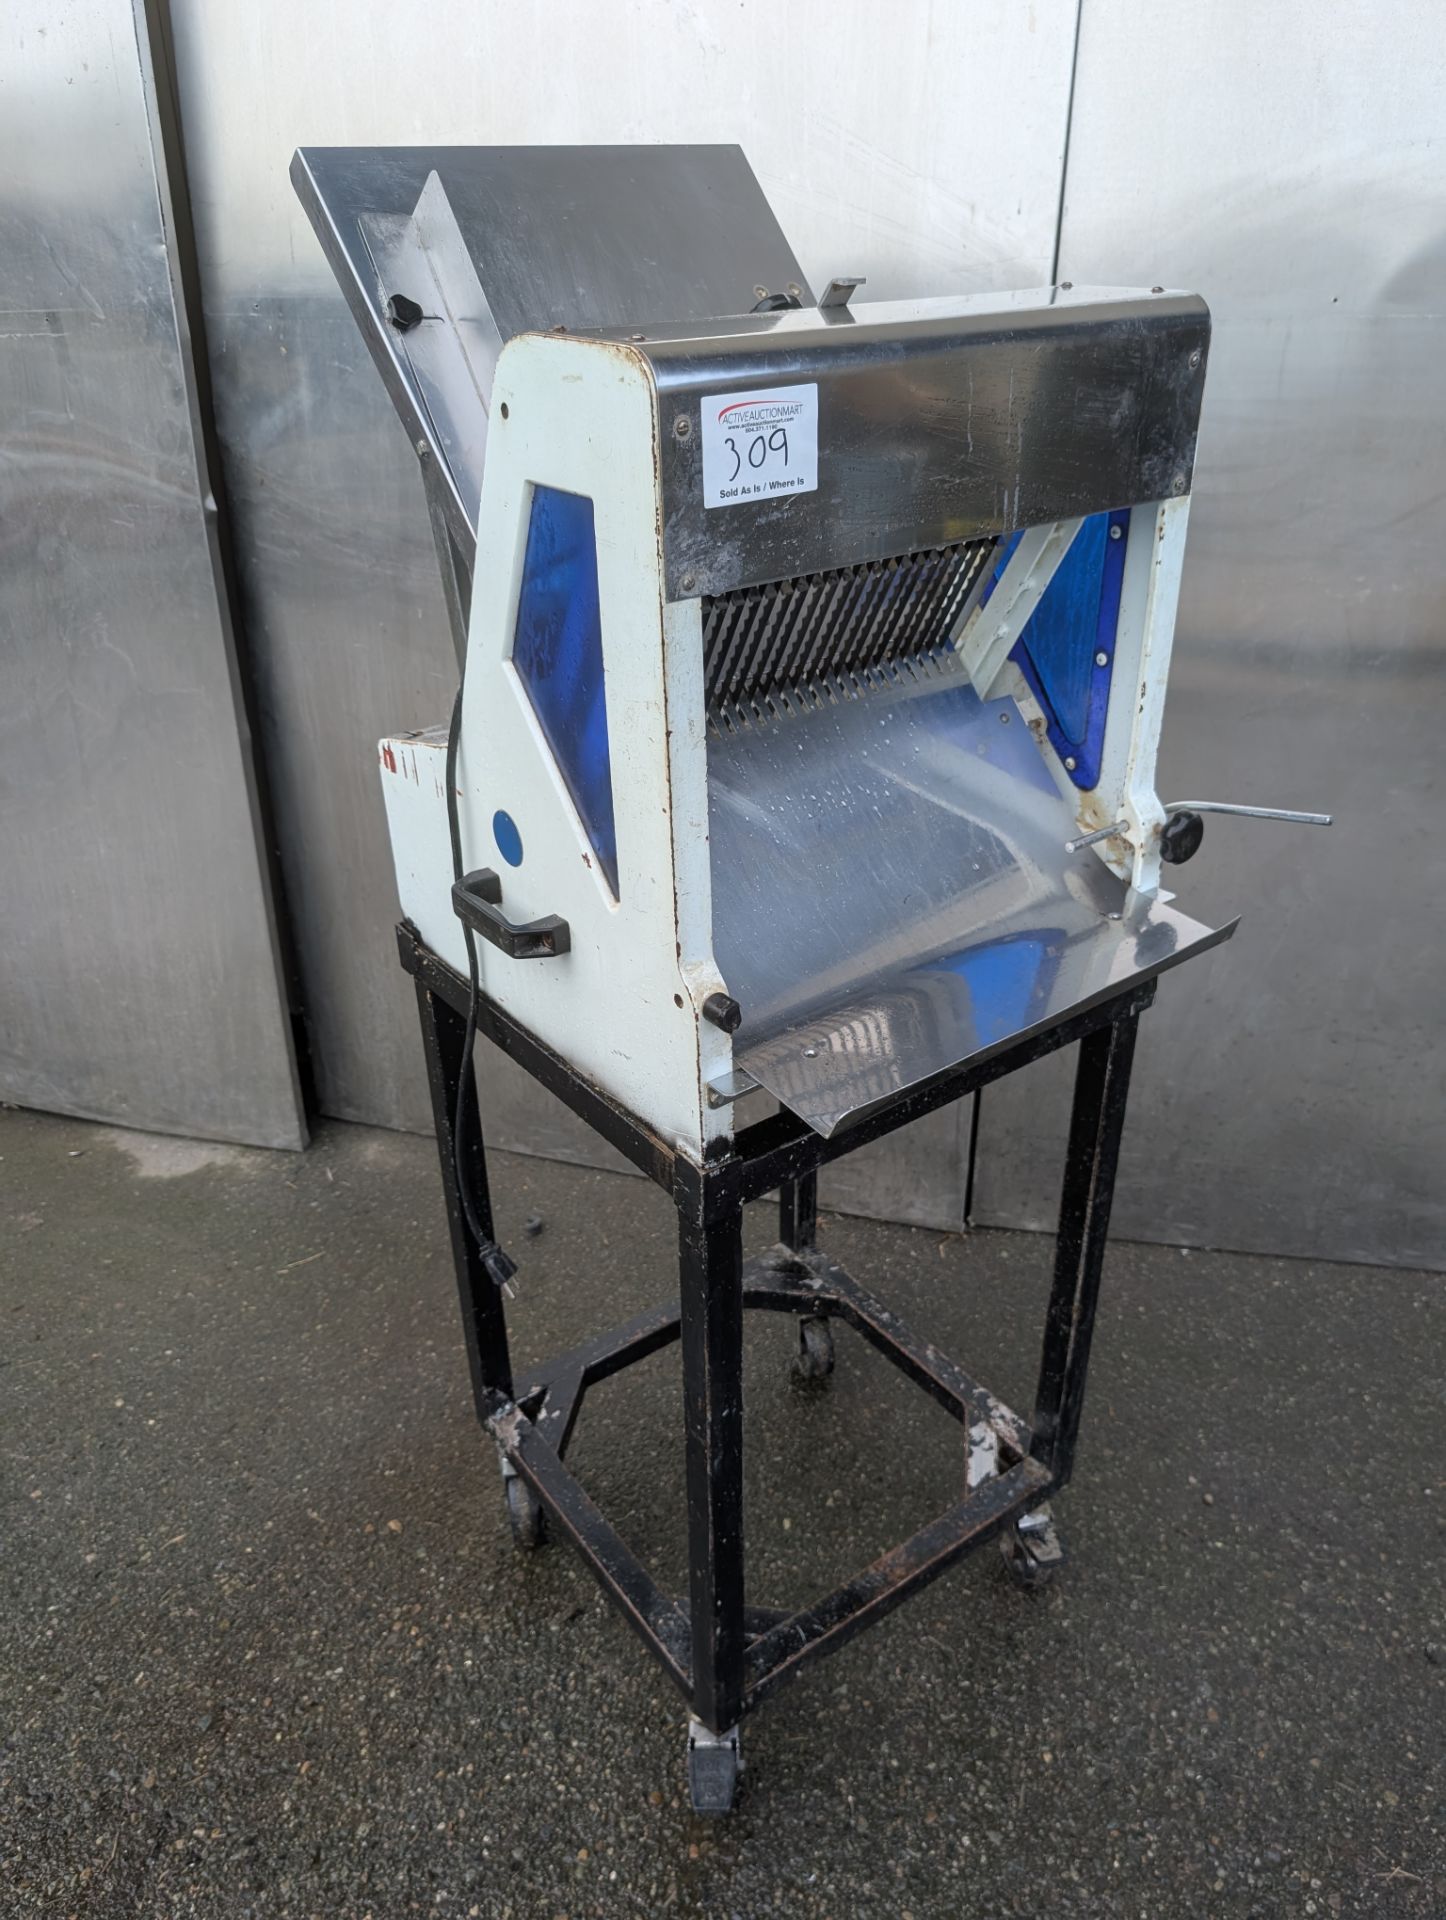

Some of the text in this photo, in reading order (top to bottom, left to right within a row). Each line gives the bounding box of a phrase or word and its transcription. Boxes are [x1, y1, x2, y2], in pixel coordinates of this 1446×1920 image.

[722, 404, 803, 425] ACTIVEAUCTIONMART
[724, 428, 788, 482] 309
[720, 488, 739, 499] Sold
[741, 486, 751, 495] As
[754, 484, 761, 492] Is
[769, 480, 795, 490] Where
[797, 477, 805, 486] Is
